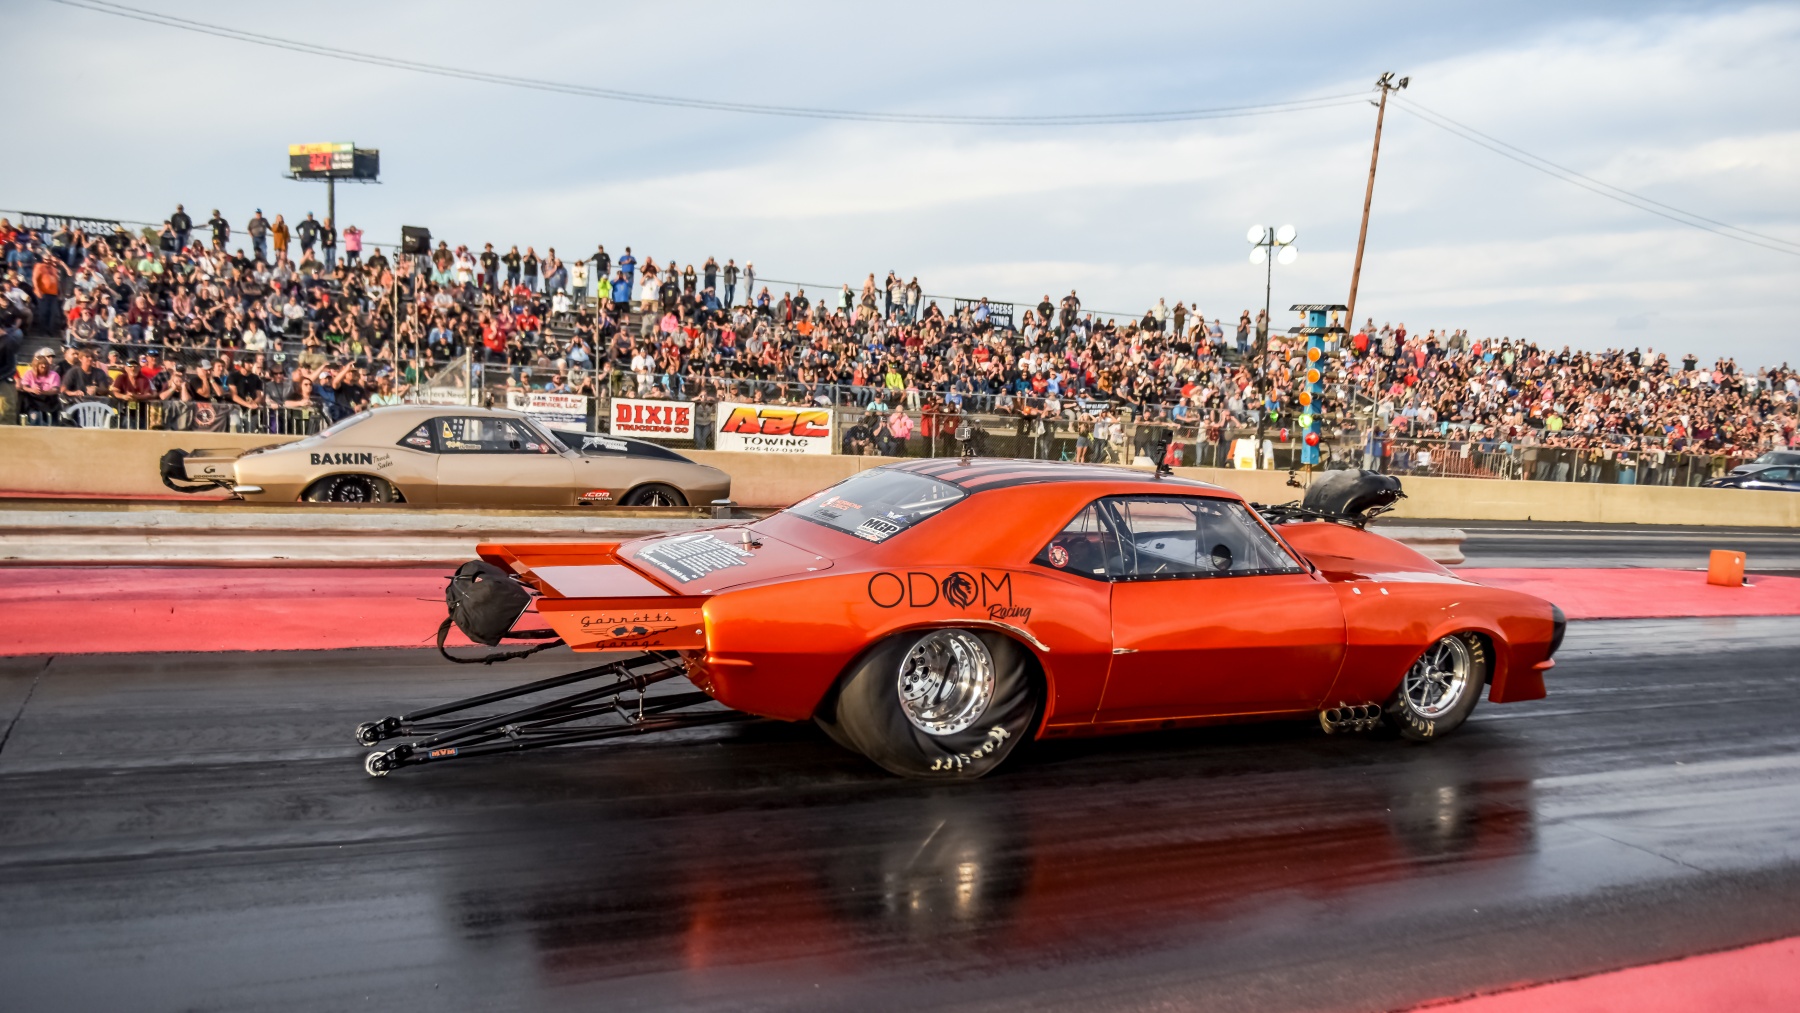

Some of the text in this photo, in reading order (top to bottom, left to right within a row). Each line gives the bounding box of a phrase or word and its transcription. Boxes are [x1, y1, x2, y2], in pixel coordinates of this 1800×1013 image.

[23, 215, 45, 230] VIP
[986, 302, 1012, 315] CCESS
[447, 390, 477, 399] Needd
[616, 403, 690, 426] DIXIE
[616, 423, 689, 434] TRUCKING CO
[719, 407, 830, 438] ABC
[741, 436, 809, 447] TOWING
[310, 452, 373, 466] BASKIN
[376, 460, 394, 471] Sales
[862, 518, 899, 533] MGP
[868, 571, 1013, 609] ODOM
[580, 613, 677, 628] Garretts
[987, 603, 1032, 625] Racing
[596, 639, 665, 651] Garage
